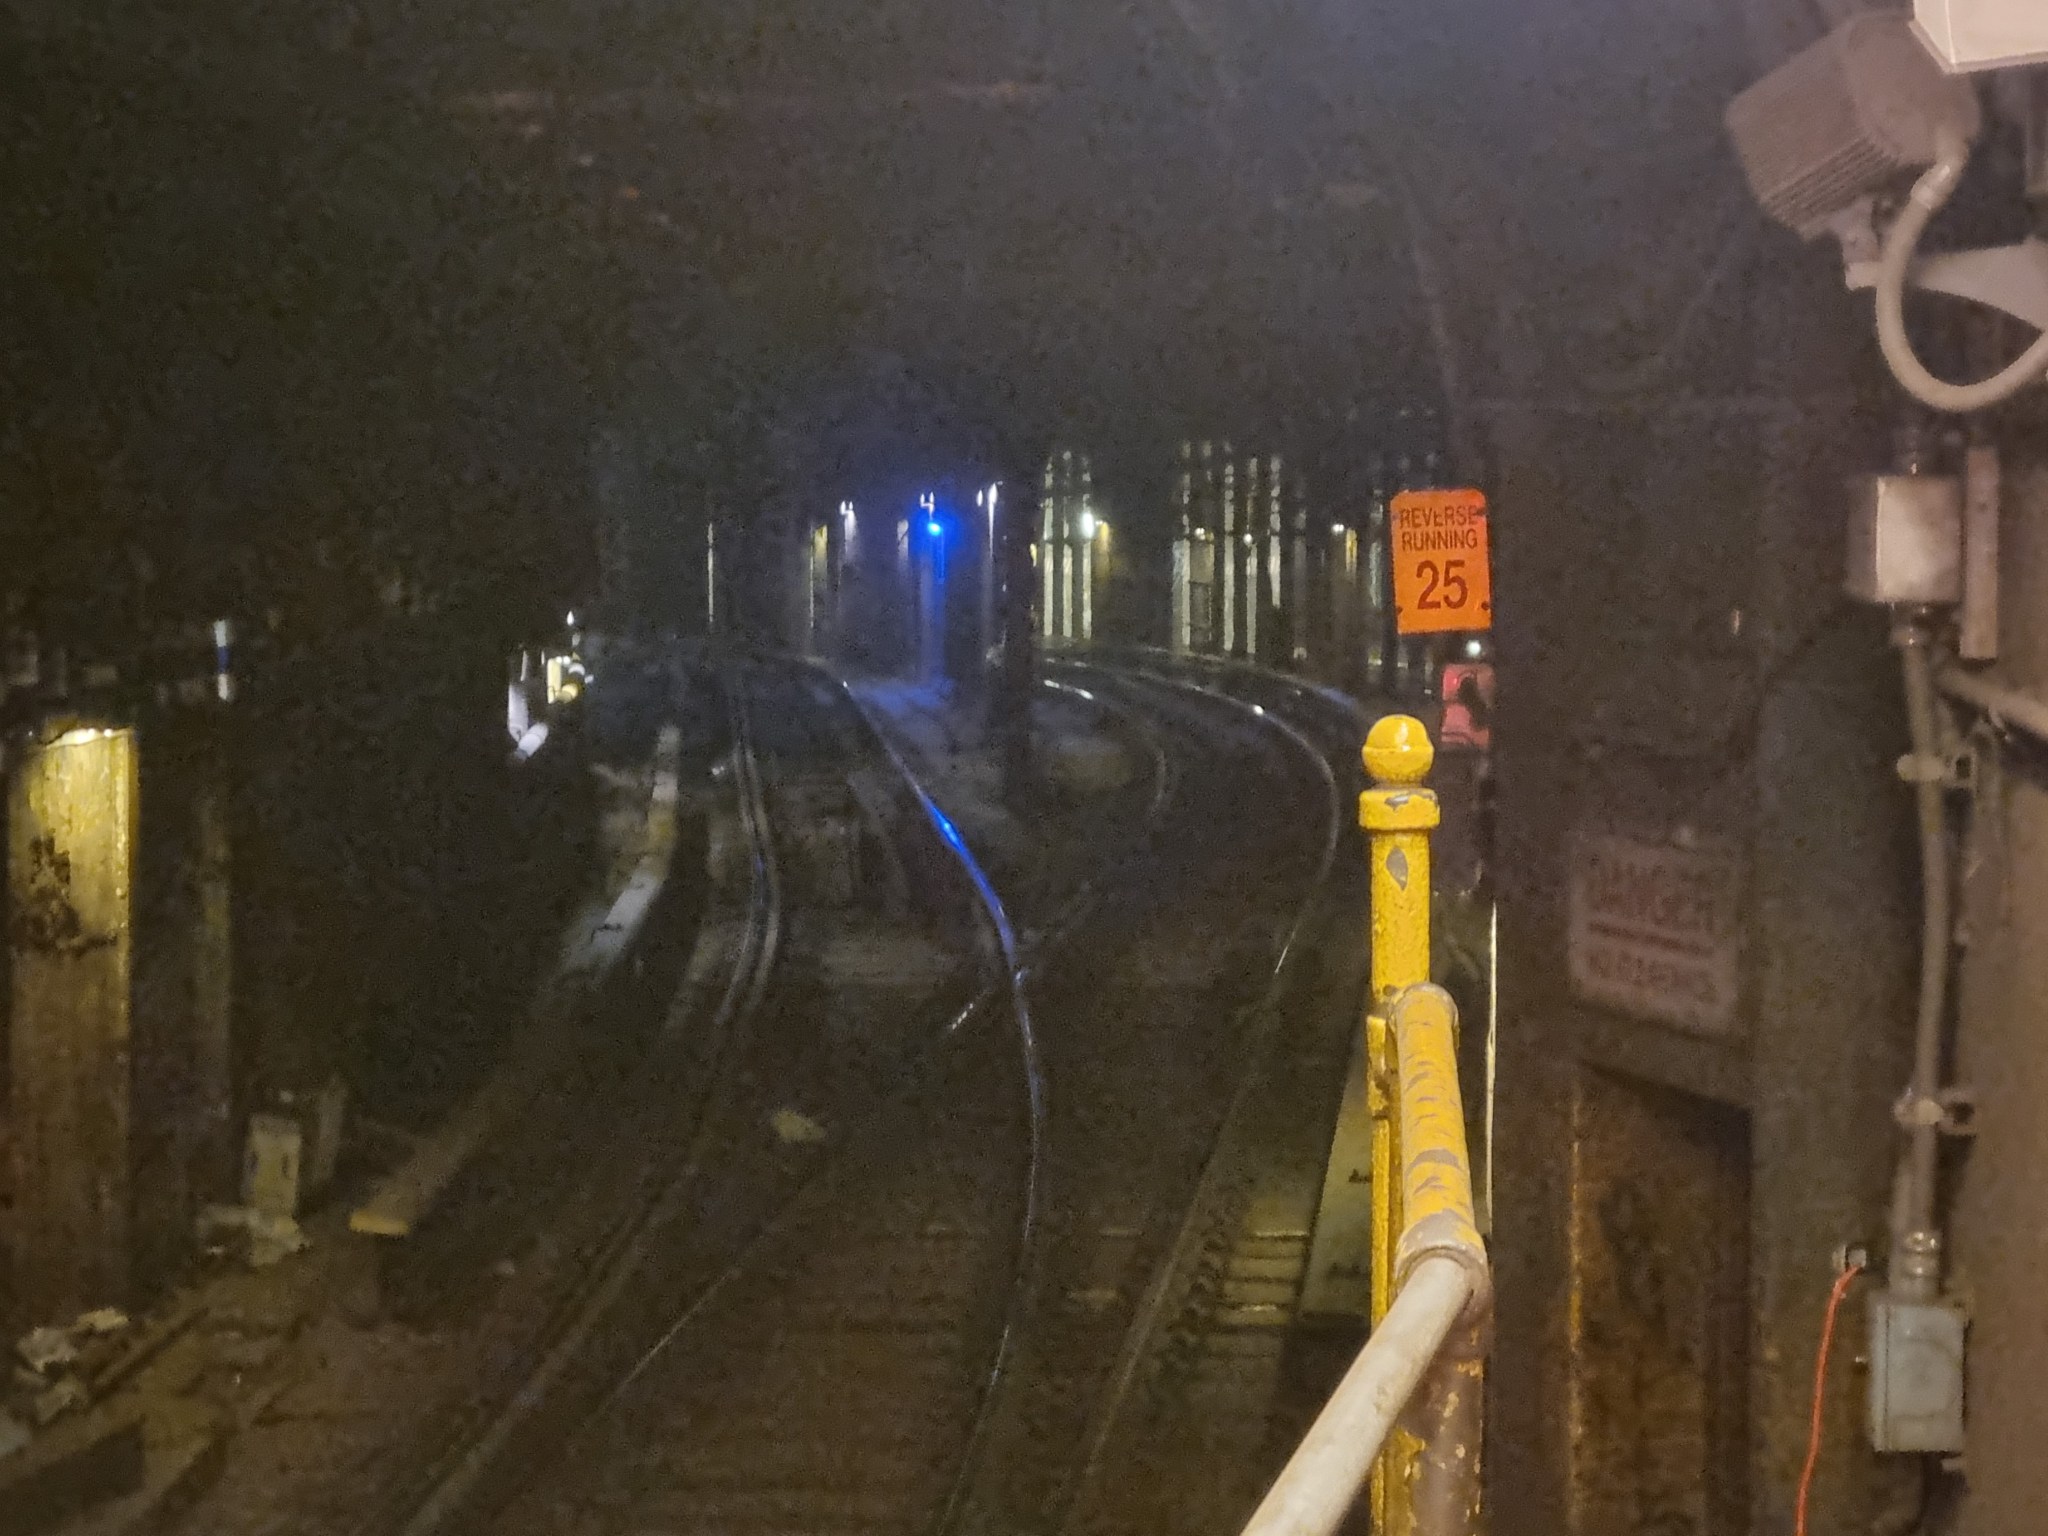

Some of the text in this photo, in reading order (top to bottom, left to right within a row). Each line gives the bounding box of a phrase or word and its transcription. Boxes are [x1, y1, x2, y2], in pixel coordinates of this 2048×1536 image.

[1400, 505, 1478, 529] REVERSE
[1401, 529, 1477, 552] RUNNING
[1416, 560, 1469, 610] 25
